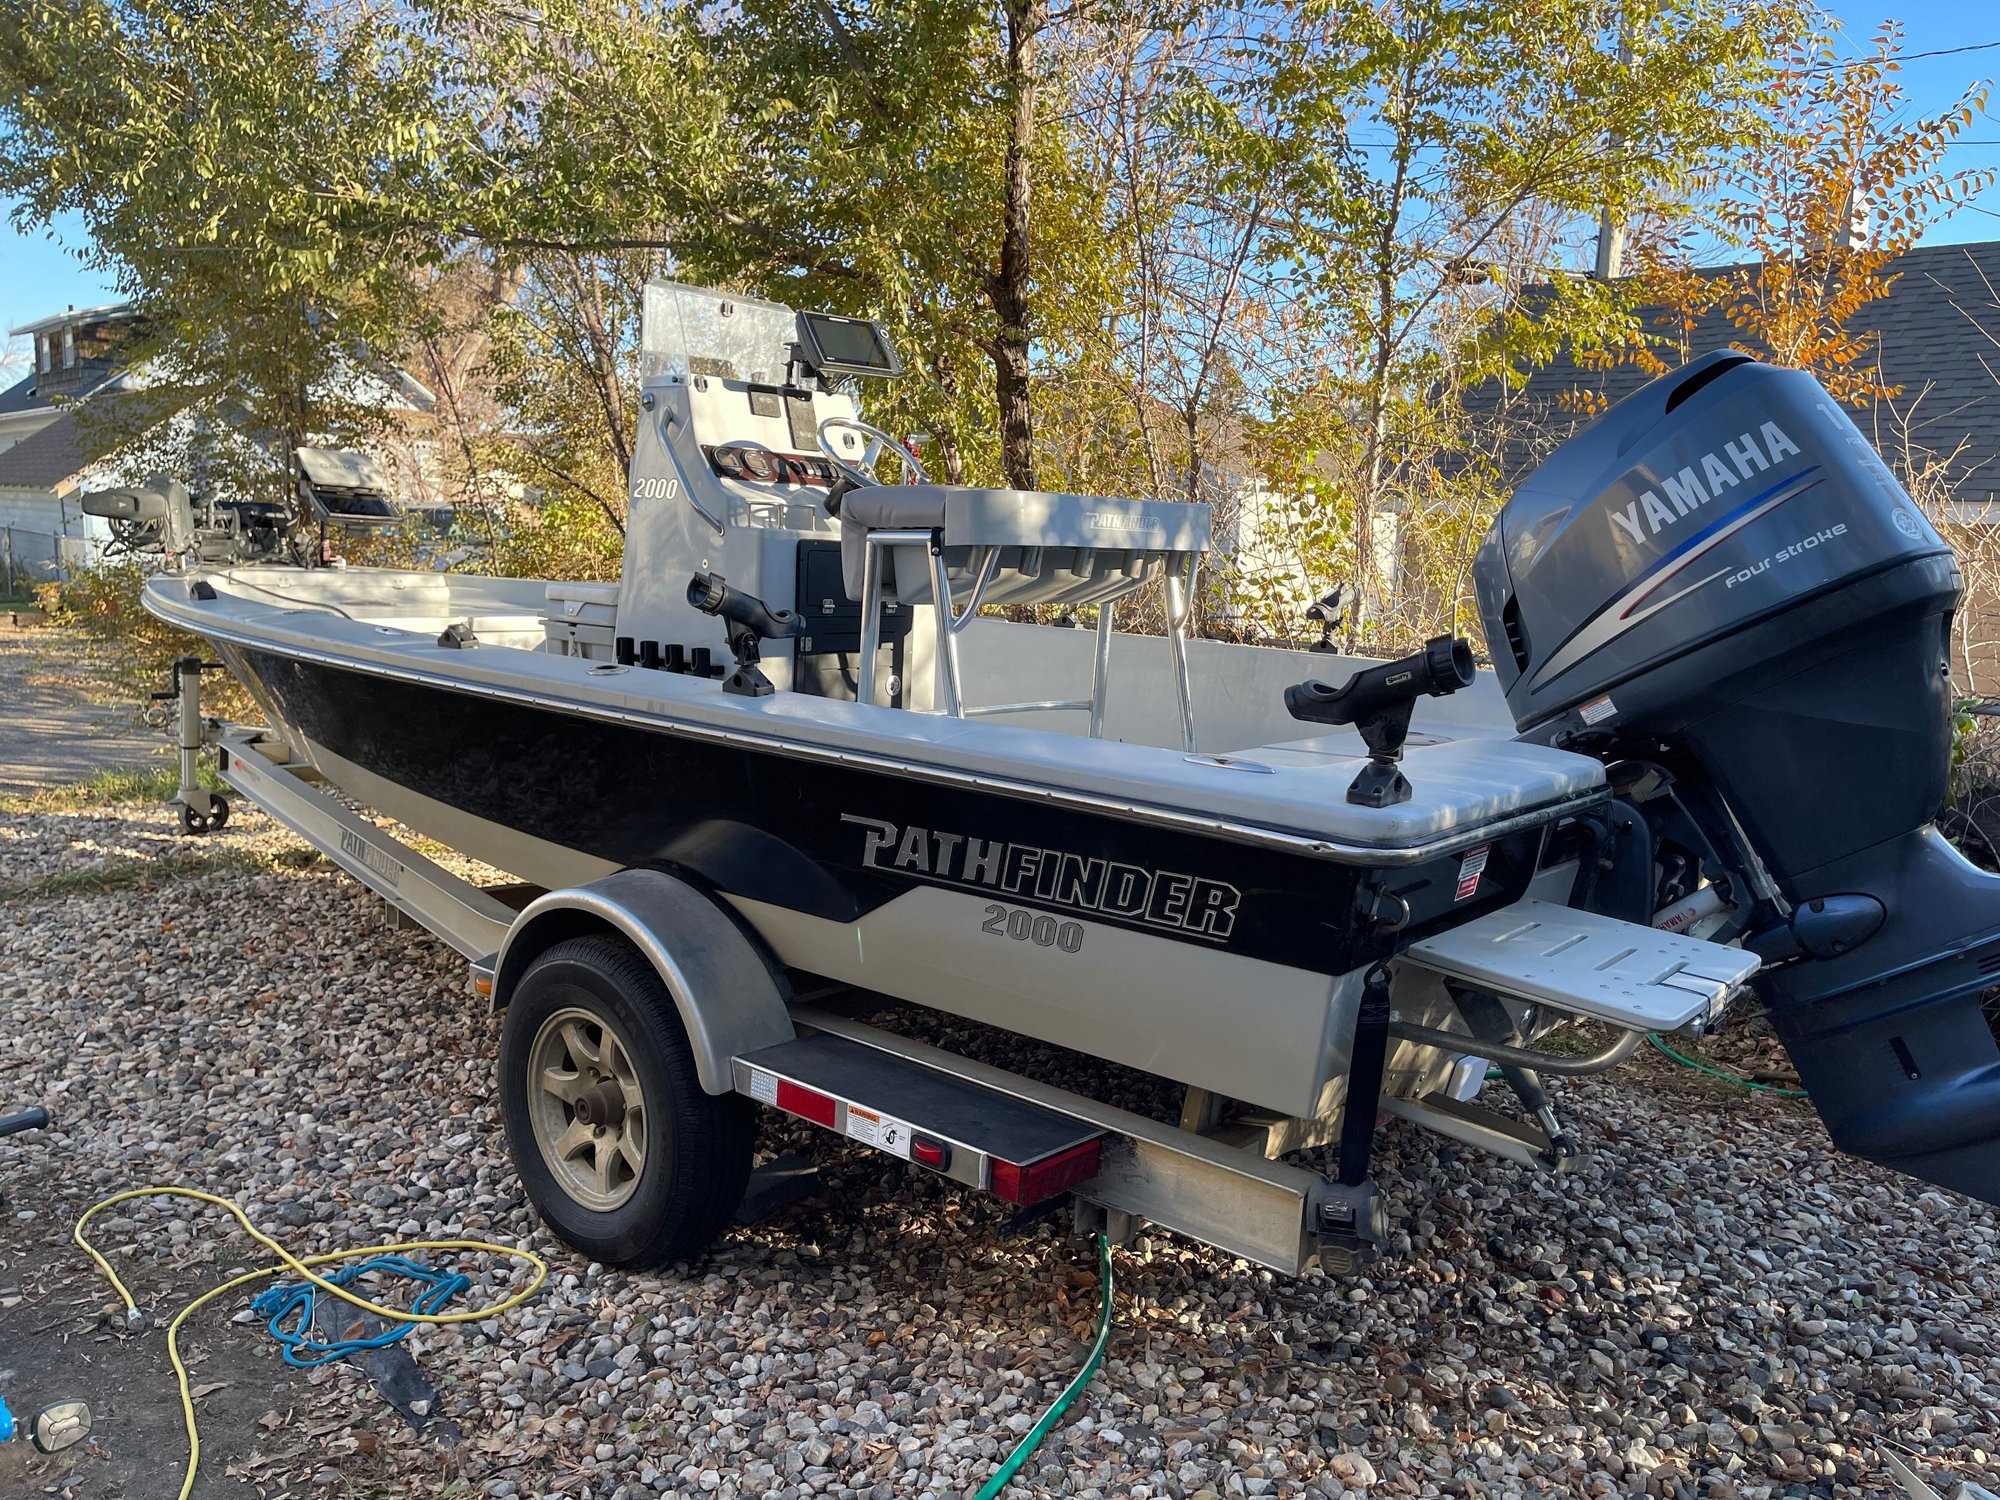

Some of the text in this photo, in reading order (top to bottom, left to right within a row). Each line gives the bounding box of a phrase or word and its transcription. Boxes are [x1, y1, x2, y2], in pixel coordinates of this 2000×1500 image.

[633, 477, 679, 500] 2000
[1611, 420, 1802, 545] YAMAHA
[1086, 512, 1160, 533] PATHFINDER
[841, 813, 1242, 937] PATHFINDER
[982, 904, 1084, 954] 2000
[1656, 911, 1690, 931] YAMAH
